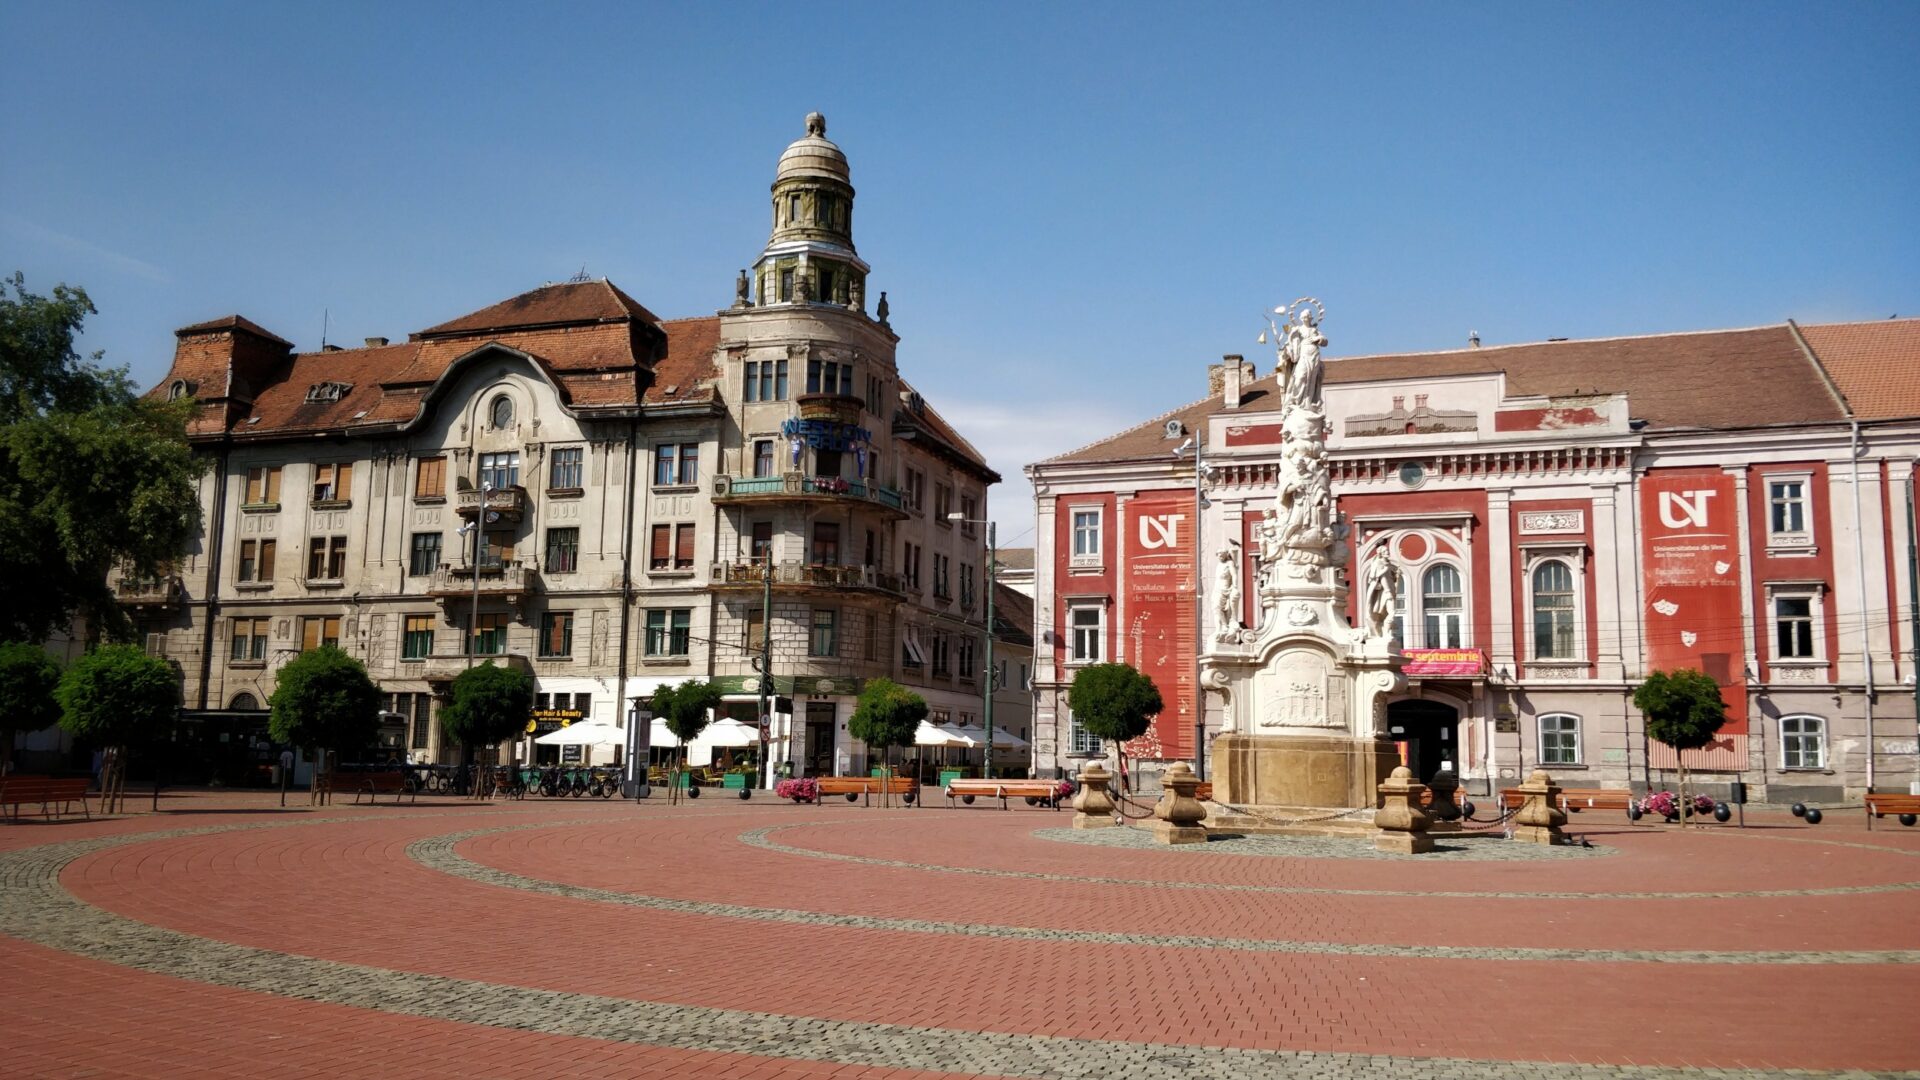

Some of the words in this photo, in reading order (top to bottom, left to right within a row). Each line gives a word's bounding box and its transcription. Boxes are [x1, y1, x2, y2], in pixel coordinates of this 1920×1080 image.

[781, 416, 838, 437] WEST
[1415, 650, 1479, 663] septembrie
[562, 709, 582, 718] Beauty
